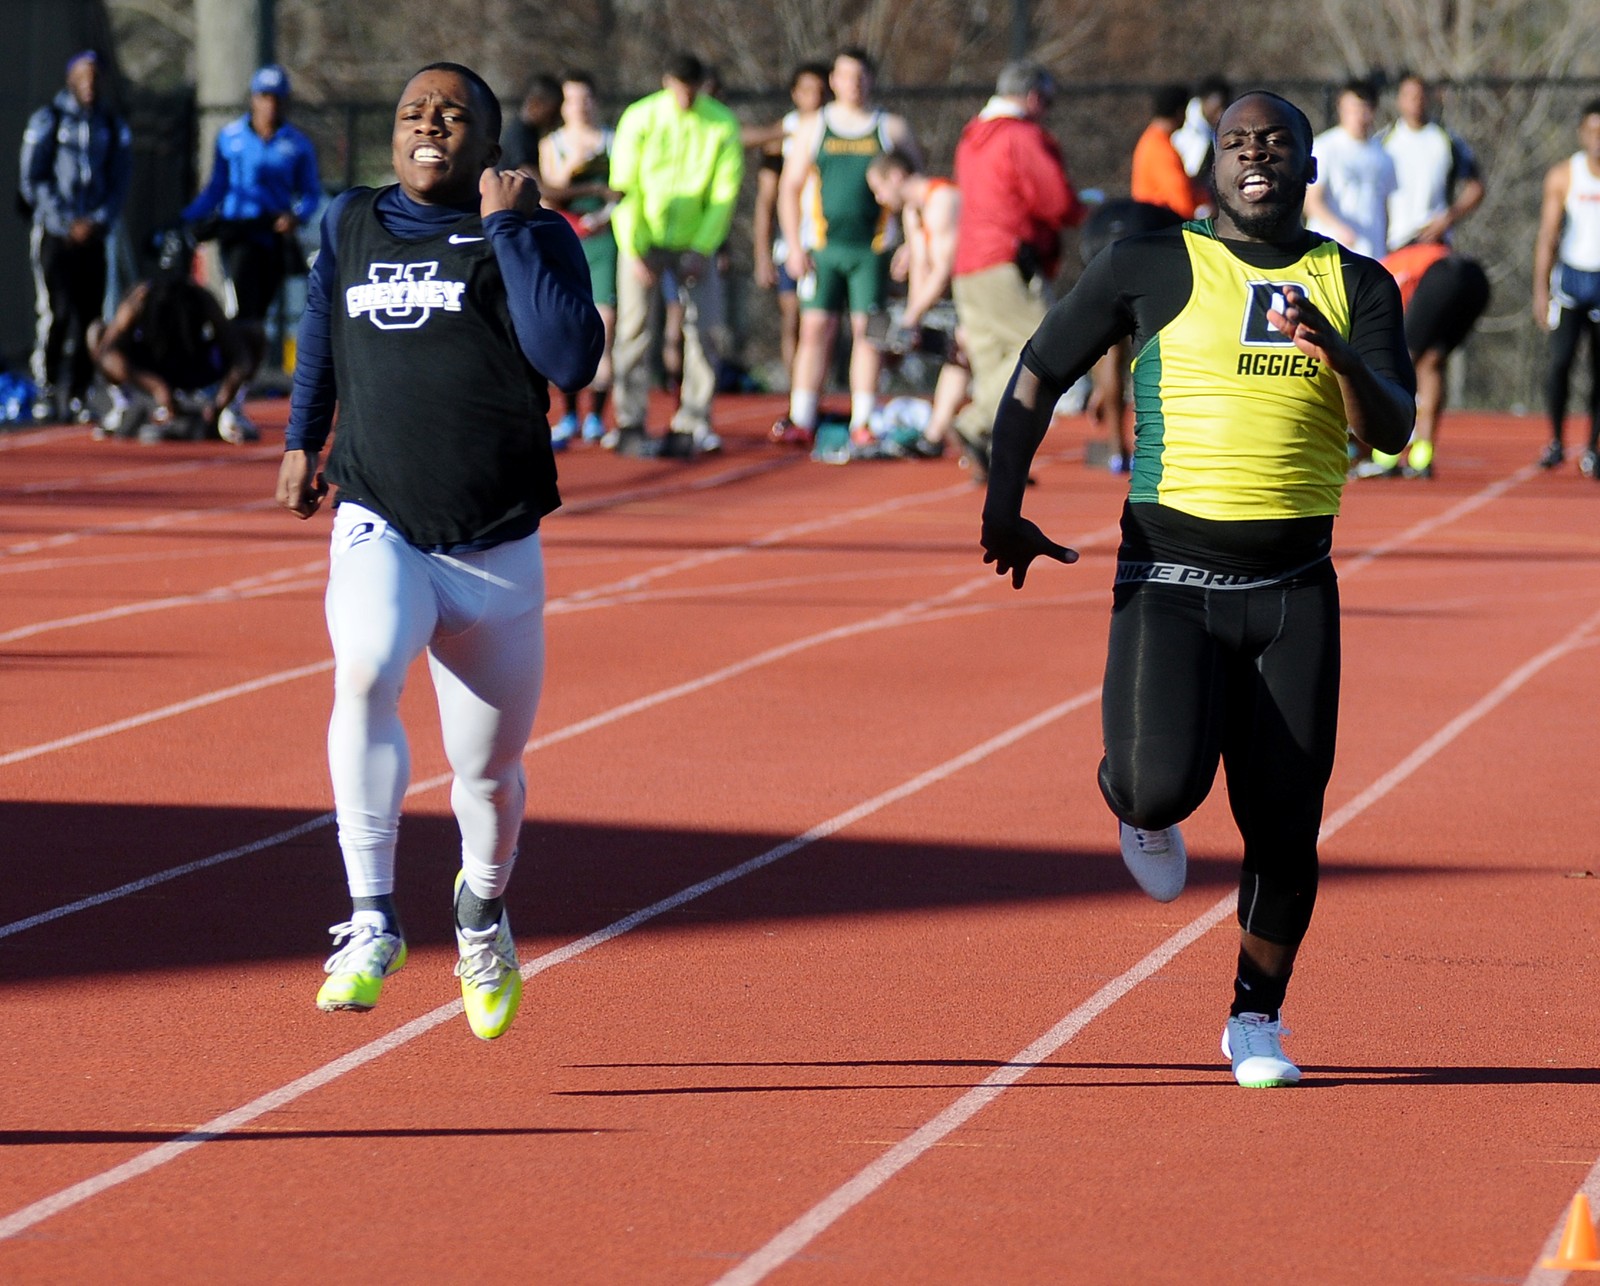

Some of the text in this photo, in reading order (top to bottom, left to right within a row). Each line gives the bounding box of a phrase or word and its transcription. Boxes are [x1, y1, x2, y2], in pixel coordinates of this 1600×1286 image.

[346, 280, 466, 318] CHEYNEY
[368, 261, 439, 330] U
[1237, 353, 1321, 378] AGGIES
